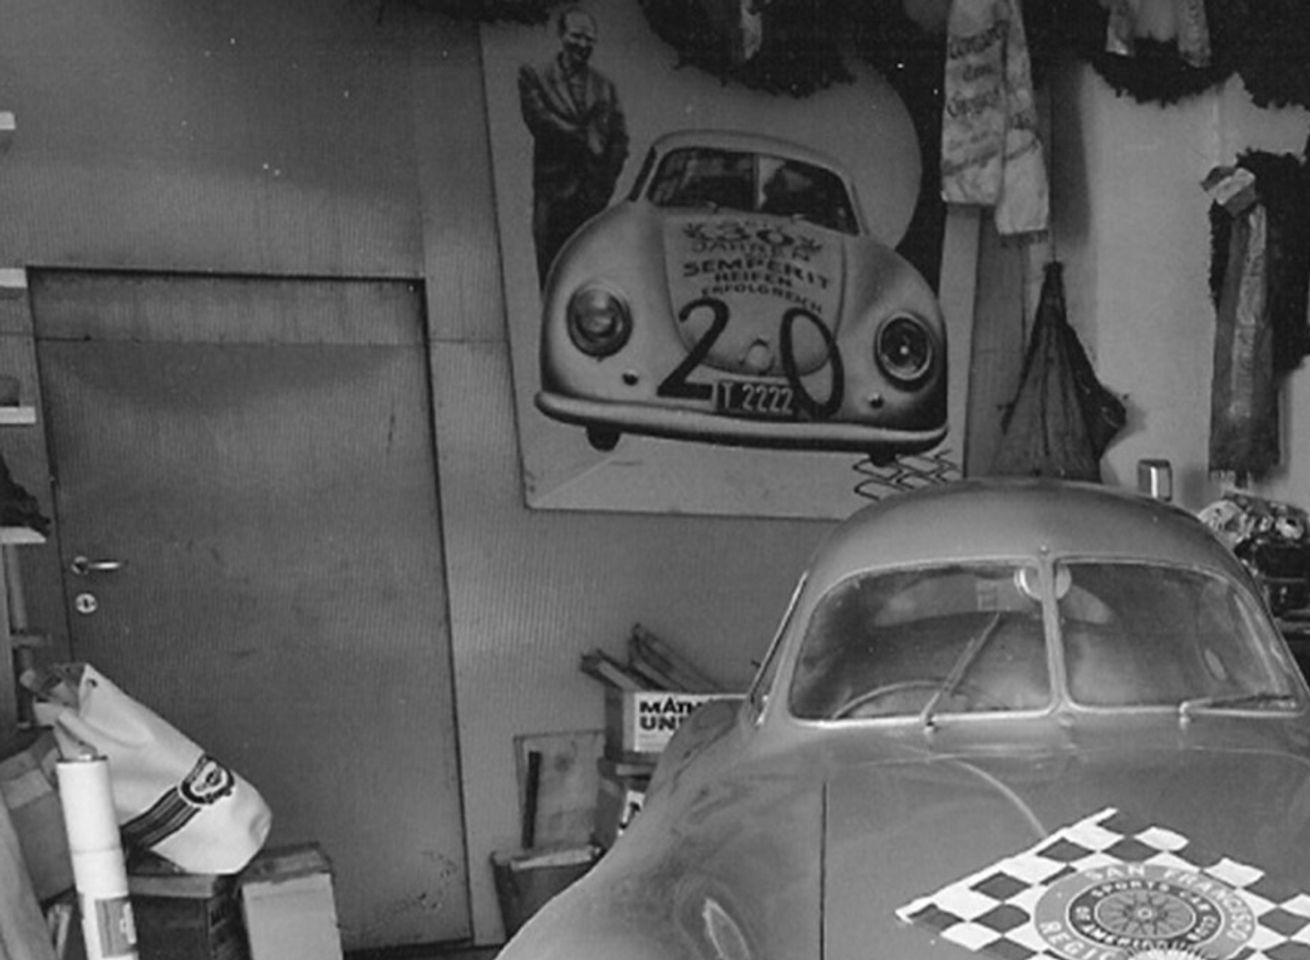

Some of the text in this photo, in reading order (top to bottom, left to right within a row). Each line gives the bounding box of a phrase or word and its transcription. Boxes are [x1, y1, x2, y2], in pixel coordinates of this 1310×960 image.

[683, 257, 830, 290] SEMPERIT
[742, 383, 794, 415] 2222
[1086, 865, 1145, 881] SAN
[1091, 880, 1170, 899] SPORTS
